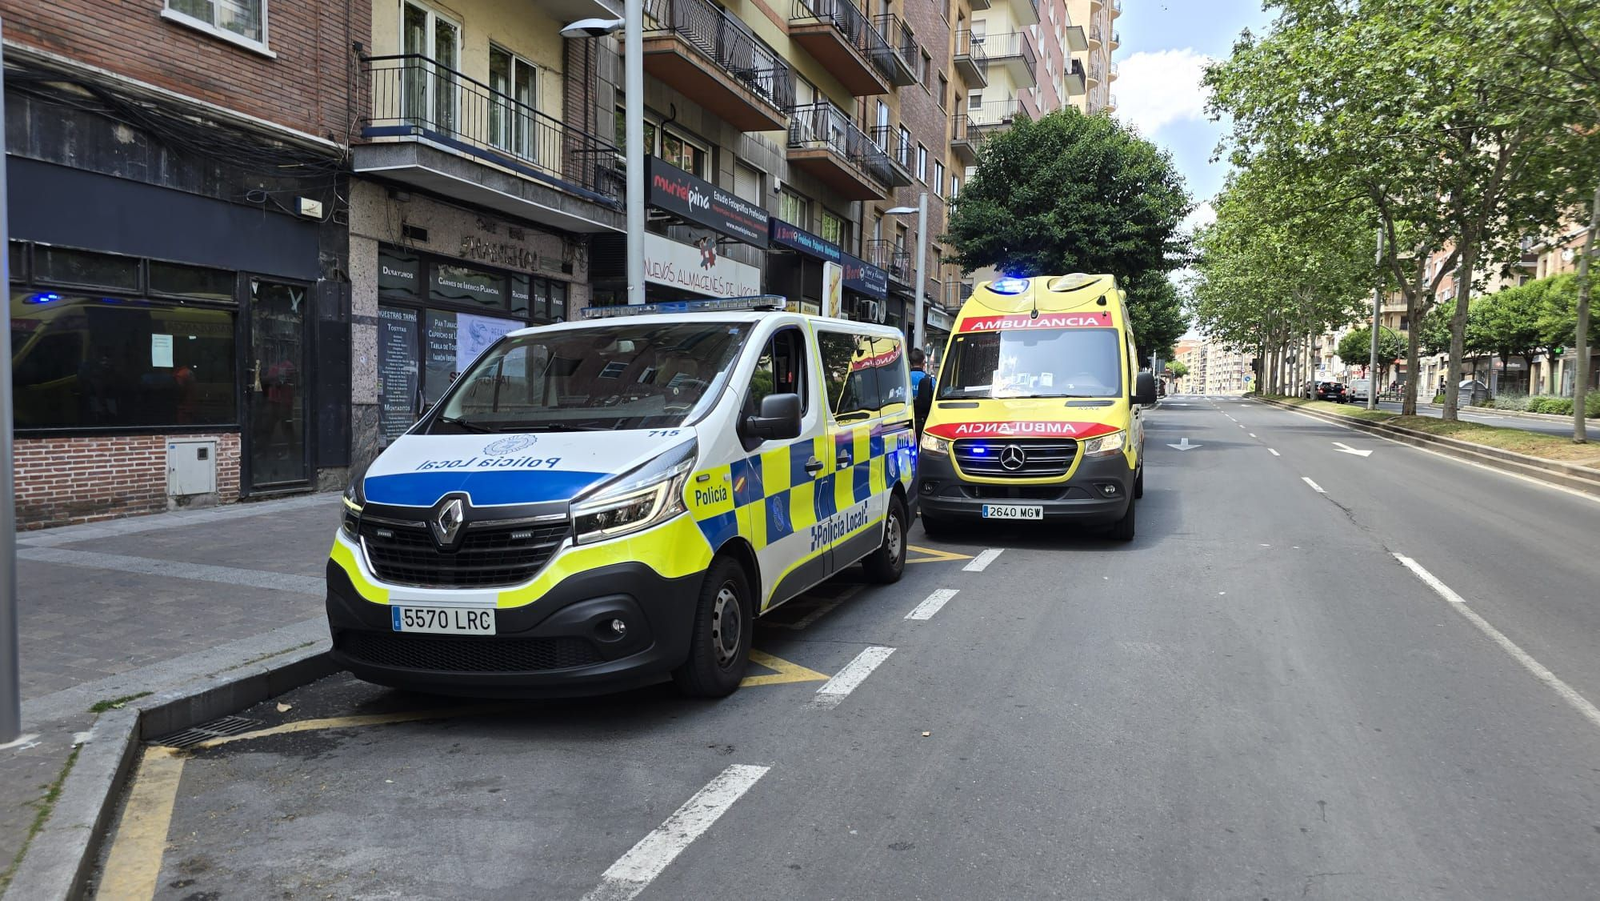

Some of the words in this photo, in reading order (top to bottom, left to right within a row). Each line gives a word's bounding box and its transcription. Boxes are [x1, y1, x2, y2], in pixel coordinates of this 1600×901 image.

[713, 190, 728, 206] Estudio
[748, 206, 768, 223] Profesional
[644, 257, 675, 282] NUEVOS
[677, 268, 724, 295] ALMACENES
[725, 281, 735, 297] DE
[970, 317, 1099, 330] AMBULANCIA
[648, 429, 681, 438] 715
[695, 484, 728, 507] Policía
[990, 506, 1017, 518] 2640
[1020, 507, 1041, 518] MGW
[817, 514, 845, 549] Policía
[846, 505, 864, 534] Local
[404, 608, 449, 629] 5570
[455, 610, 491, 631] LRC
